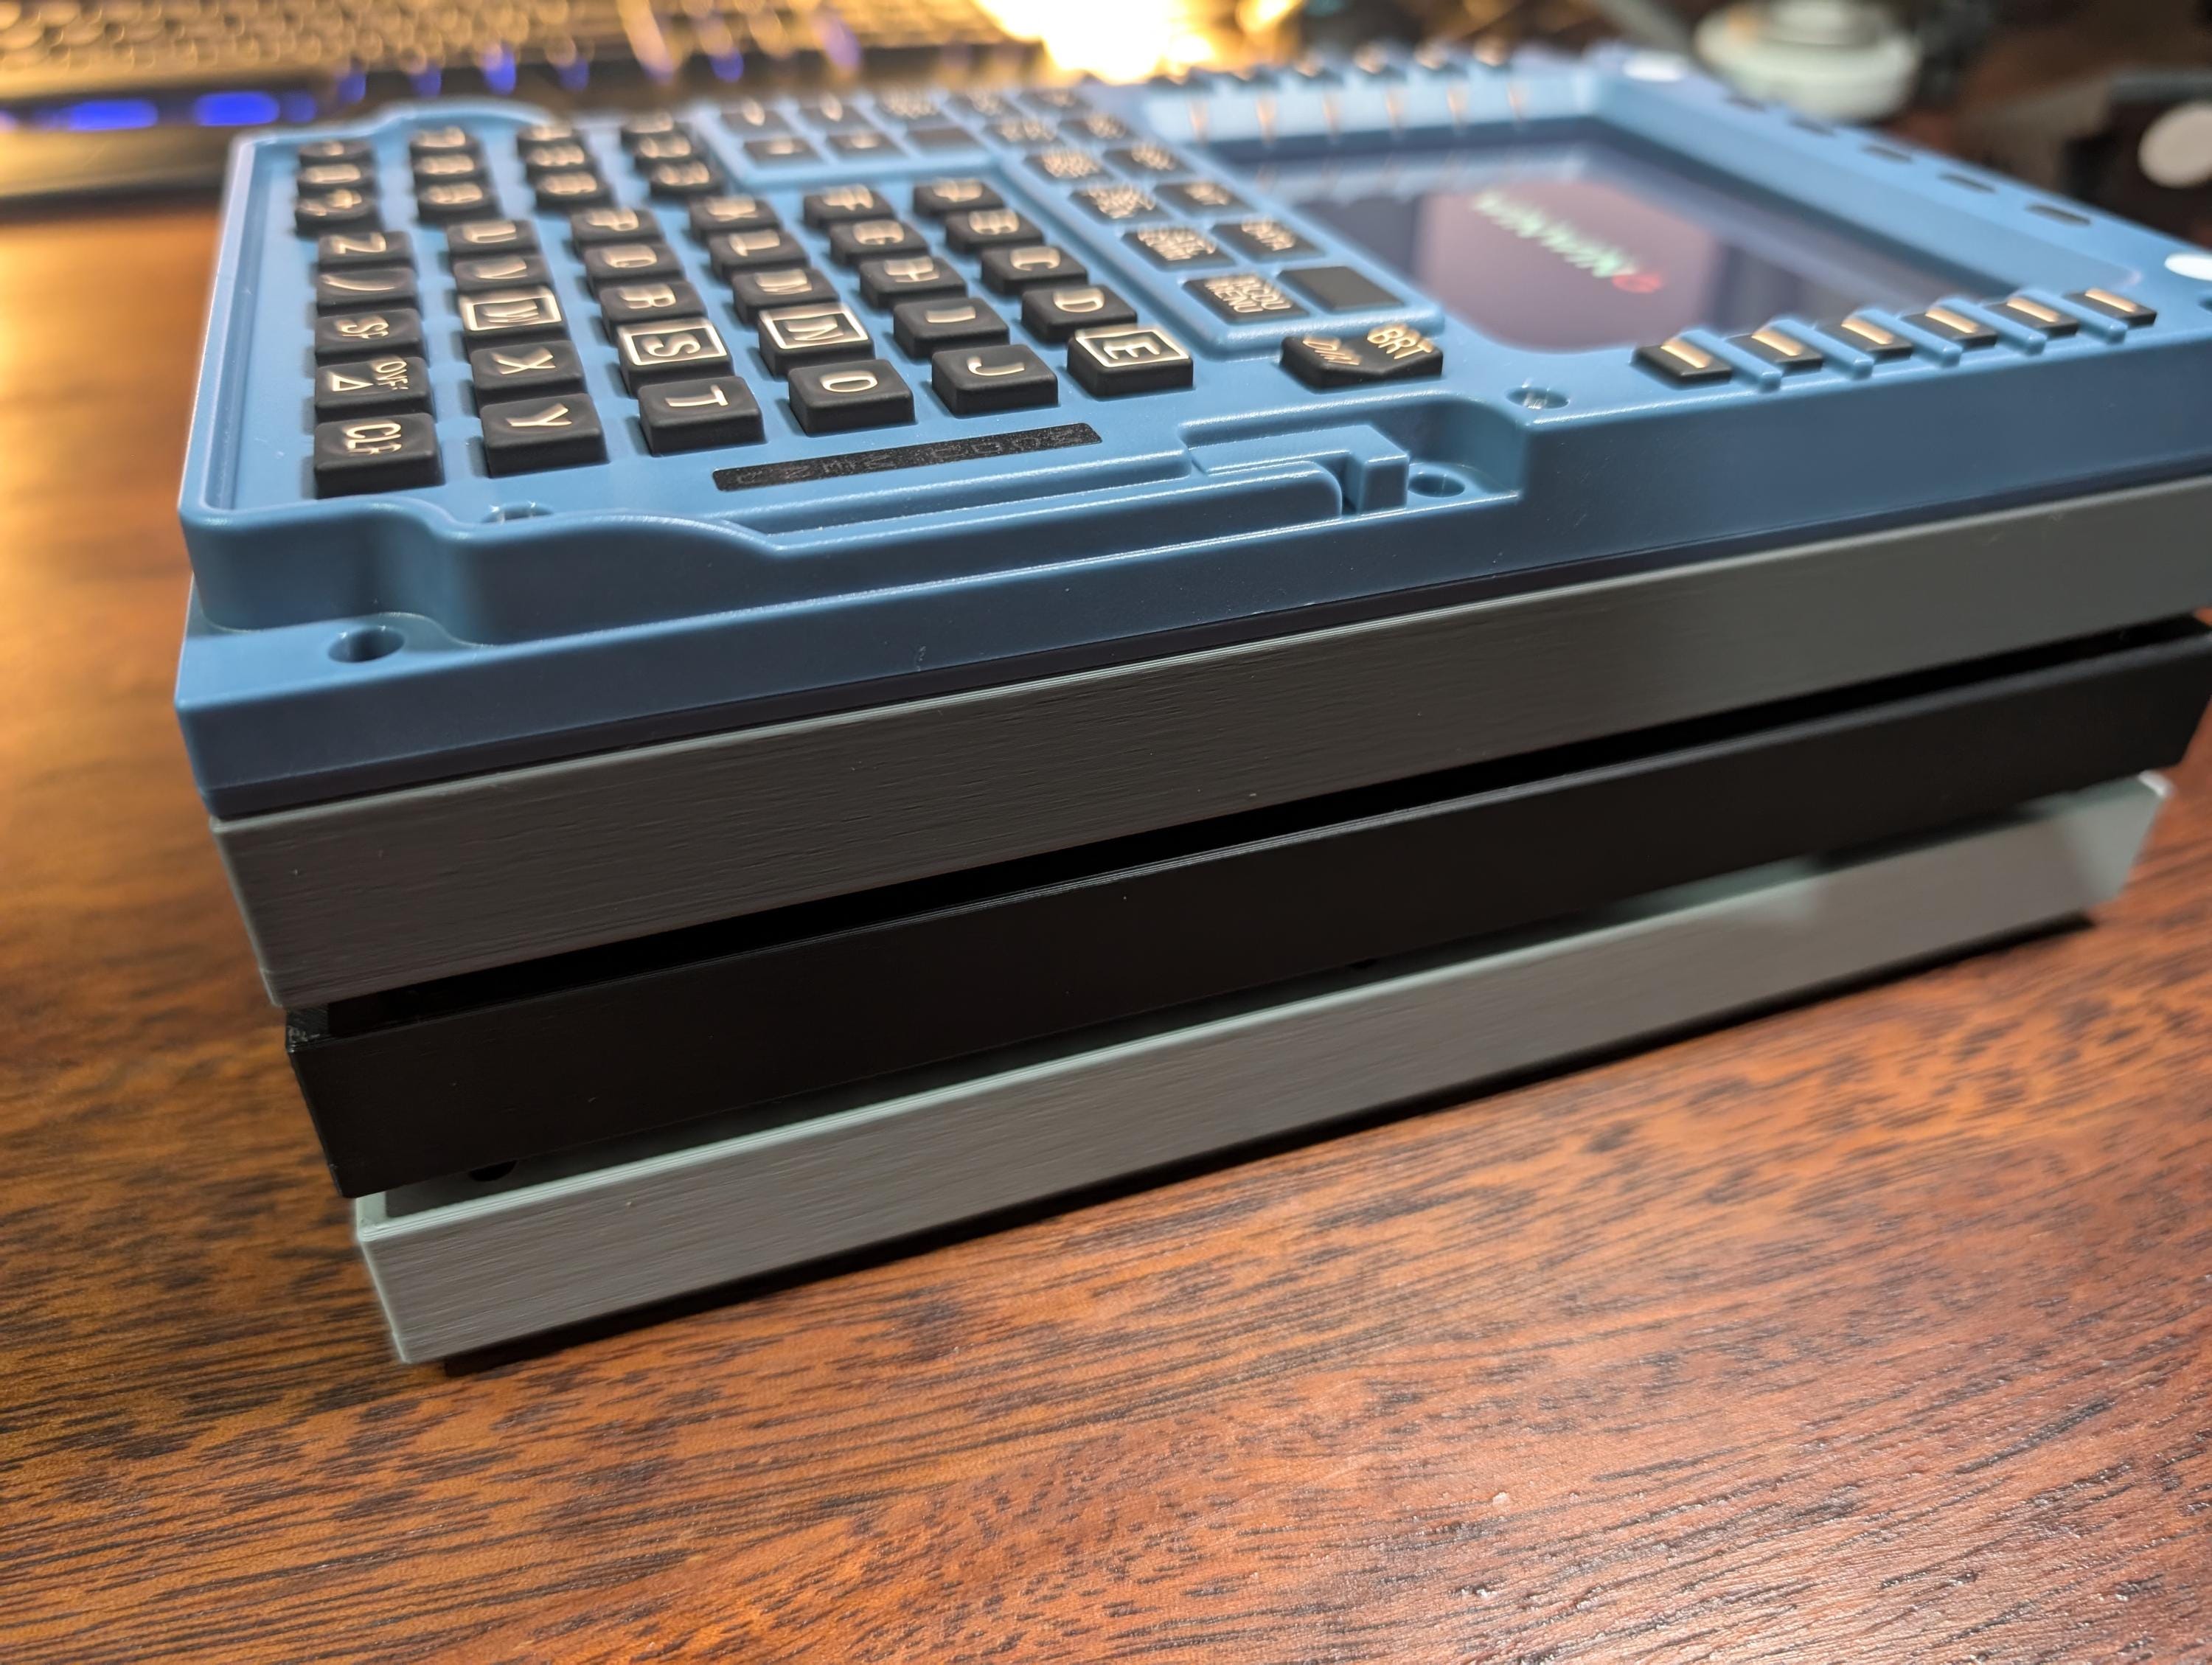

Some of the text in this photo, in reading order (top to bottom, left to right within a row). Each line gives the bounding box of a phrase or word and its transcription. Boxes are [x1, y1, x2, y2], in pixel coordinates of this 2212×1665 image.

[463, 221, 516, 243] U
[588, 208, 639, 232] P
[968, 209, 1019, 234] B
[331, 232, 386, 254] Z
[728, 229, 780, 257] L
[885, 256, 939, 282] H
[1010, 246, 1060, 271] C
[619, 284, 676, 309] R
[1053, 286, 1105, 312] D
[785, 316, 844, 341] N
[1367, 321, 1433, 359] BRT
[642, 333, 700, 357] S
[1103, 336, 1161, 360] E
[491, 347, 556, 375] X
[967, 356, 1025, 376] J
[665, 384, 728, 407] T
[506, 403, 572, 427] Y
